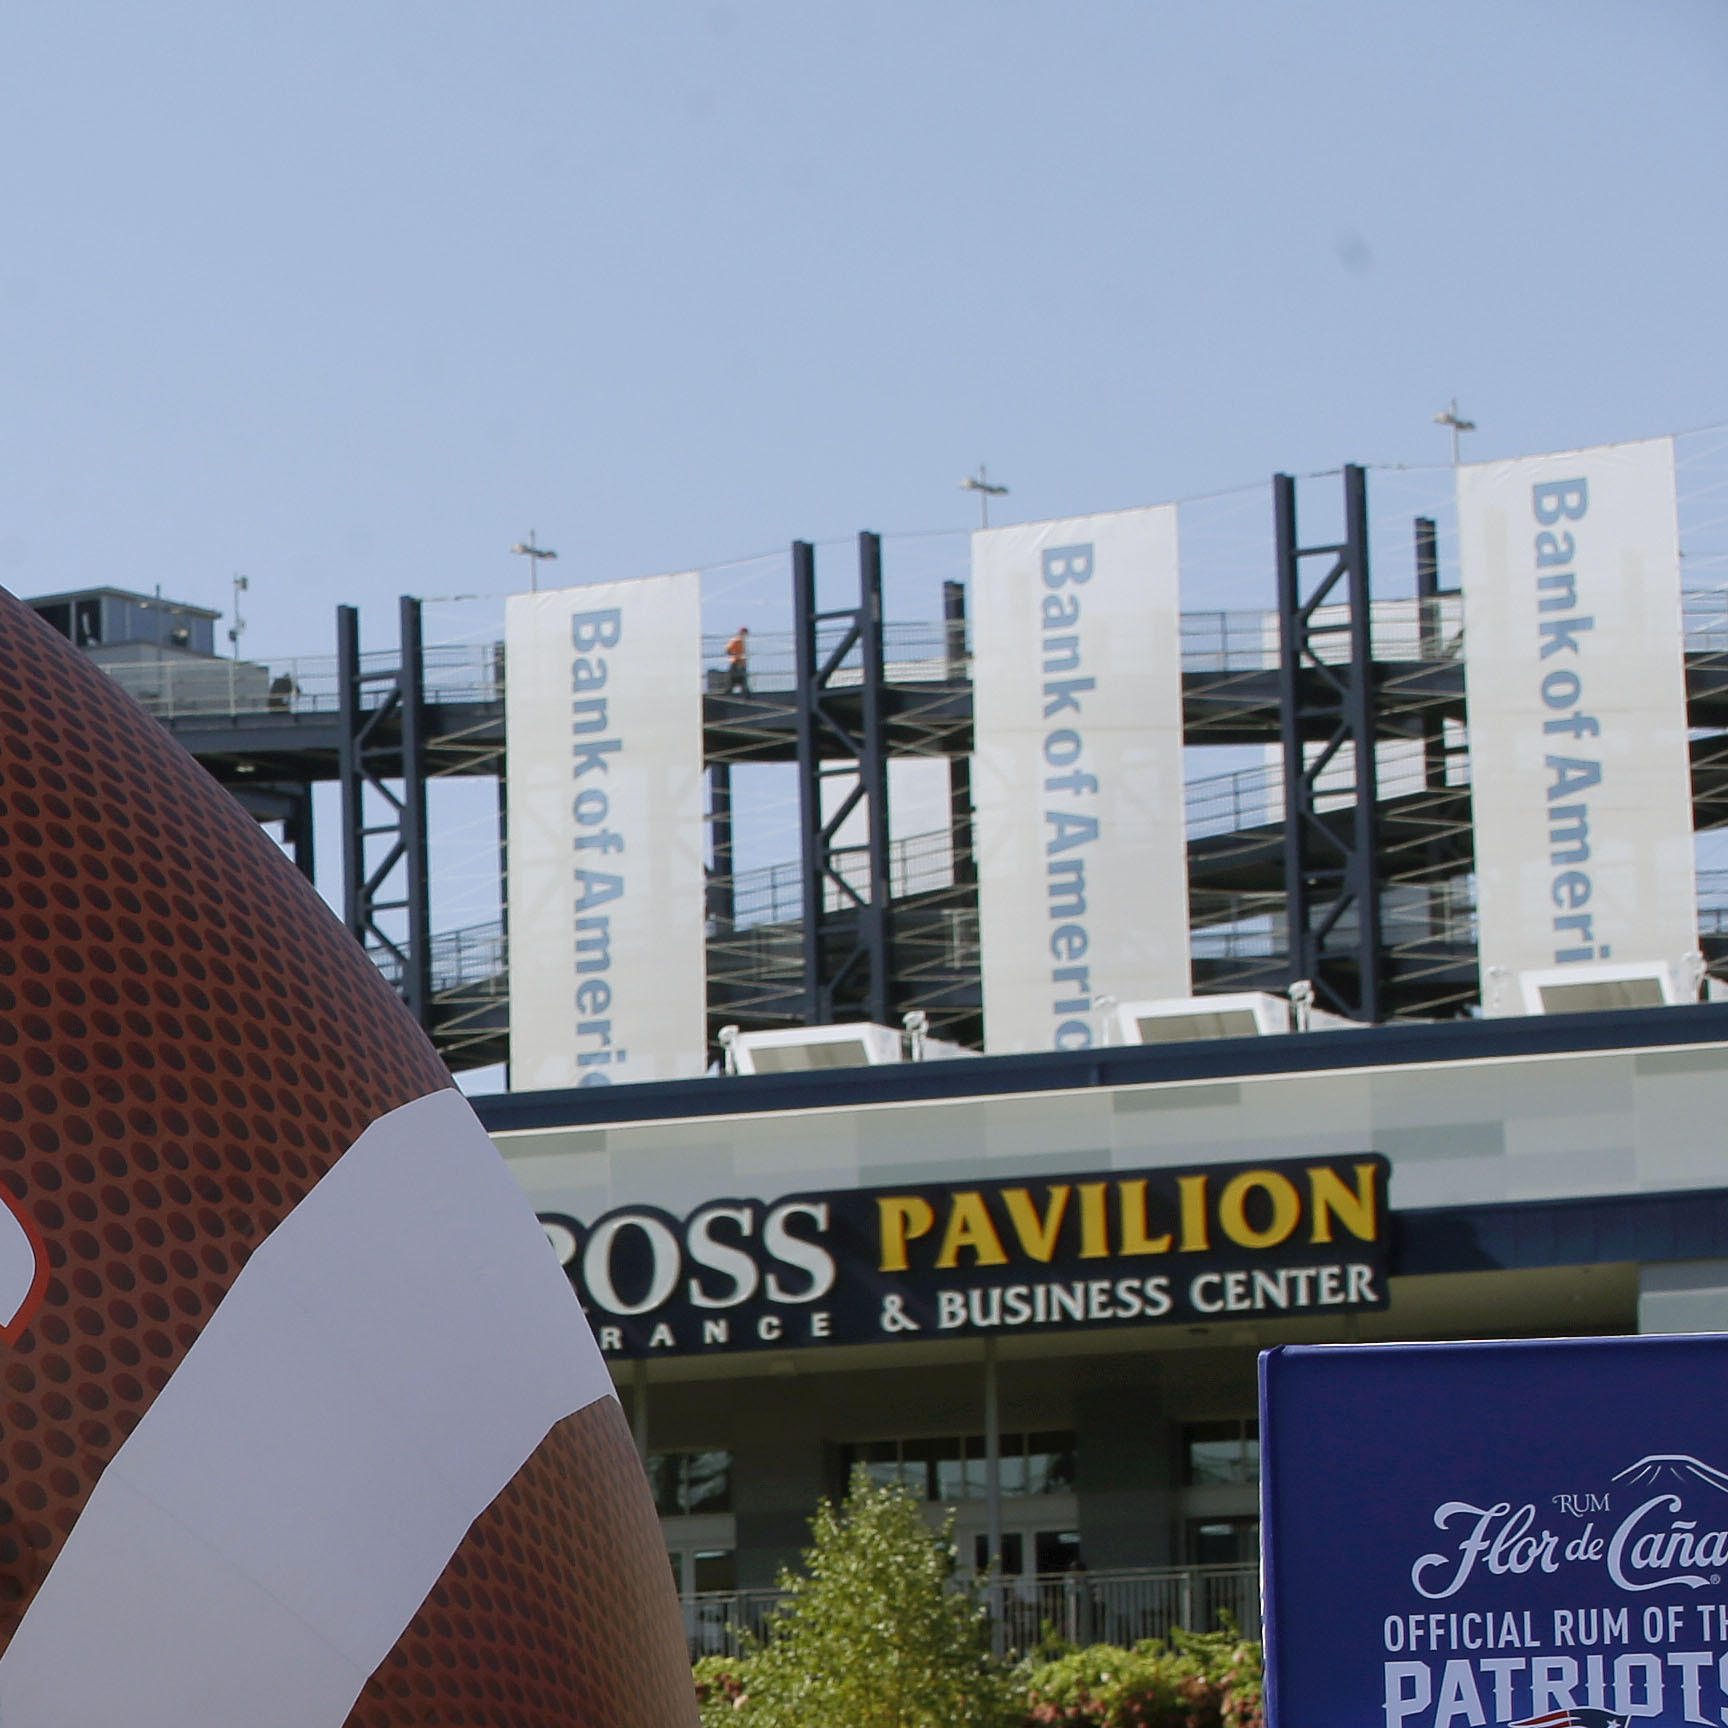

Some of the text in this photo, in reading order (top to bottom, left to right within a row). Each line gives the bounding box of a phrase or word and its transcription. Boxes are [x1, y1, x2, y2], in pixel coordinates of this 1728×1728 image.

[1532, 477, 1593, 661] Bank
[1041, 543, 1095, 721] Bank
[570, 608, 623, 778] Bank
[1541, 671, 1600, 739] of
[1045, 728, 1099, 796] of
[573, 789, 624, 854] of
[877, 1162, 1378, 1273] PAVILION
[879, 1264, 1380, 1333] & BUSINESS CENTER
[1553, 1493, 1611, 1518] RUM
[1412, 1494, 1728, 1599] Flor de Caña
[1384, 1611, 1541, 1652] OFFICIAL
[1554, 1607, 1629, 1646] RUM
[1645, 1605, 1683, 1643] OF
